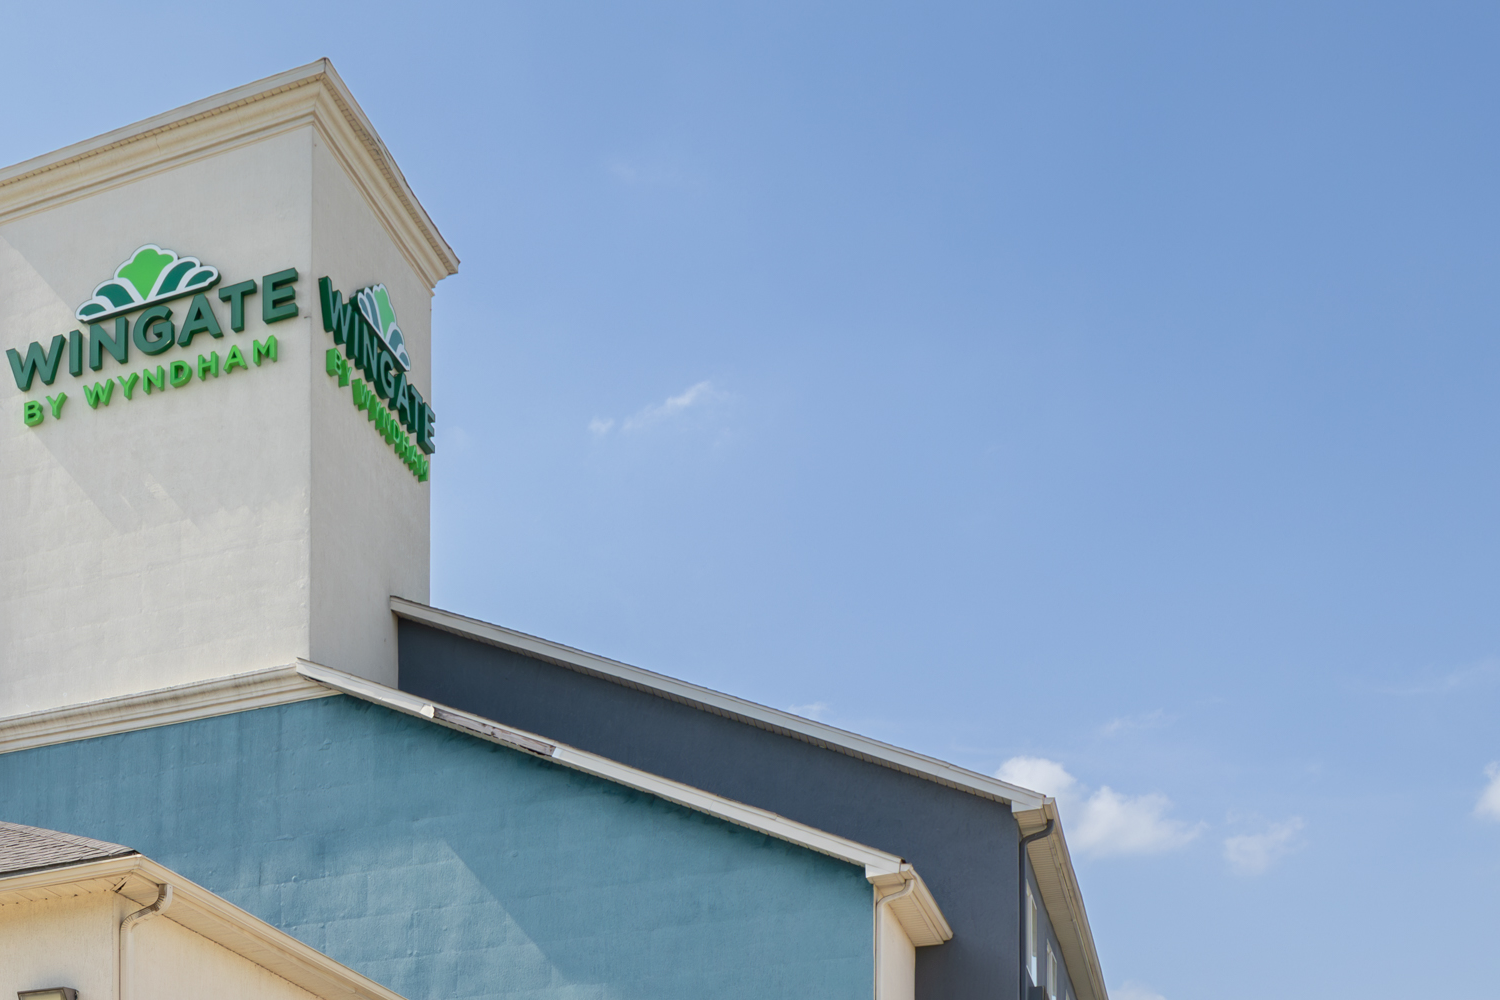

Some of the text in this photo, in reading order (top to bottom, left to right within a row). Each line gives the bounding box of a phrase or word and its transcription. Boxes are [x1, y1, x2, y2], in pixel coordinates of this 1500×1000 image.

[6, 267, 299, 392] WINGATE
[23, 335, 278, 427] BY WYNDHAM
[318, 275, 436, 455] WINGATE
[326, 347, 429, 483] BY WYNDHAM
